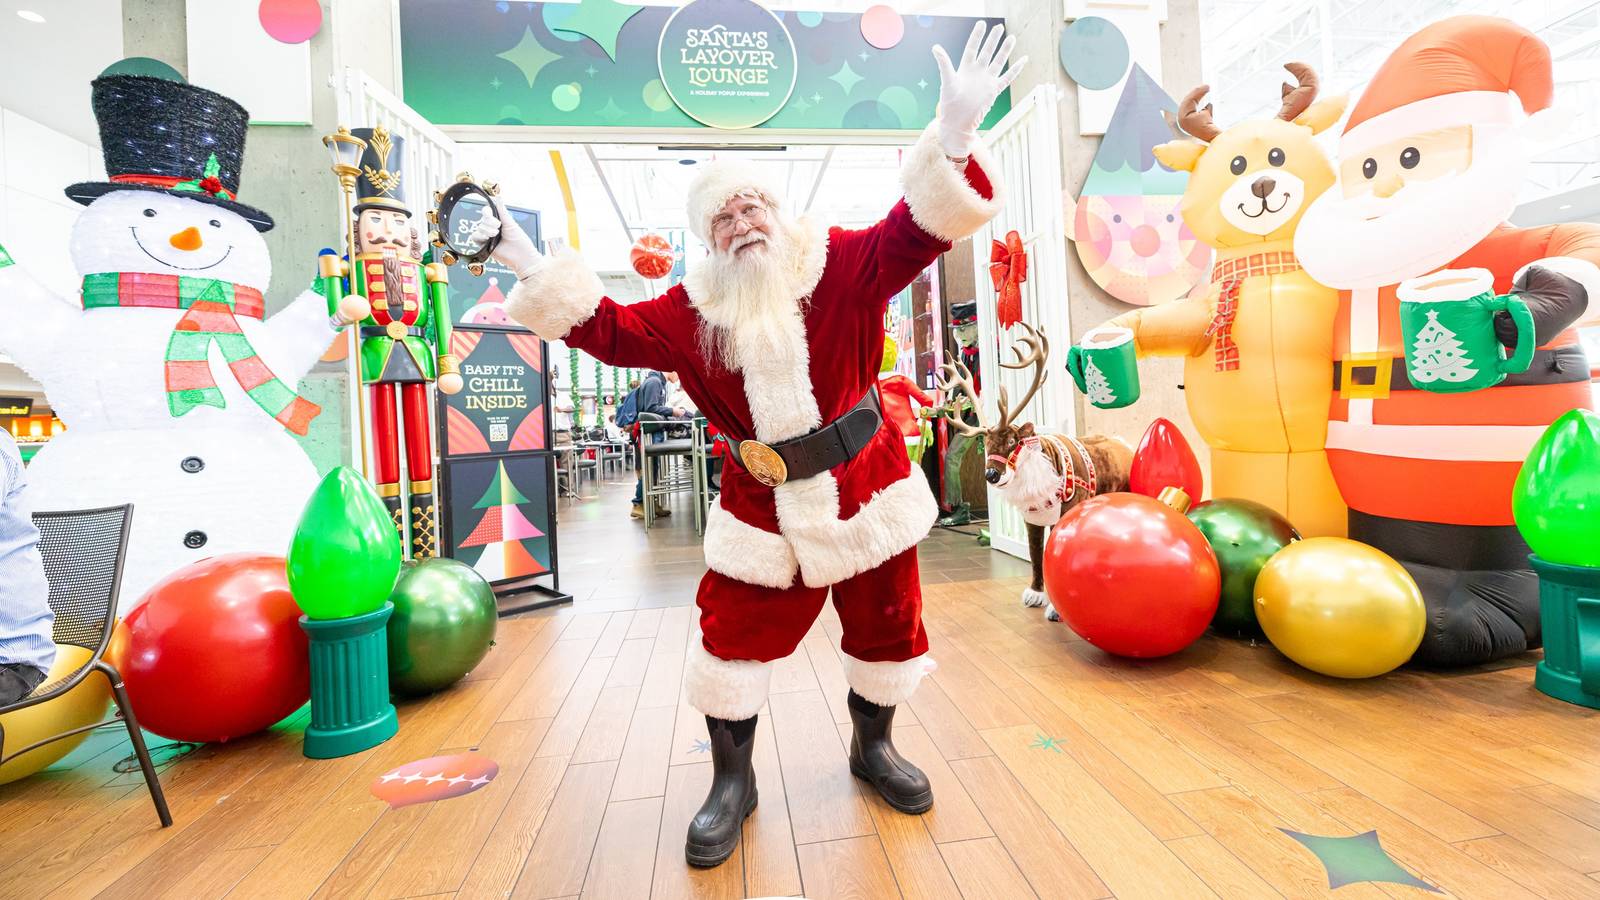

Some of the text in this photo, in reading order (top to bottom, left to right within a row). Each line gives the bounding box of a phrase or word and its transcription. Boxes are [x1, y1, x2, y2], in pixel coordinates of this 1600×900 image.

[685, 24, 769, 49] SANTA'S
[680, 48, 778, 69] LAYOVER
[688, 67, 769, 86] LOUNGE
[464, 365, 525, 376] BABY IT'S
[469, 377, 524, 392] CHILL
[465, 395, 527, 412] INSIDE
